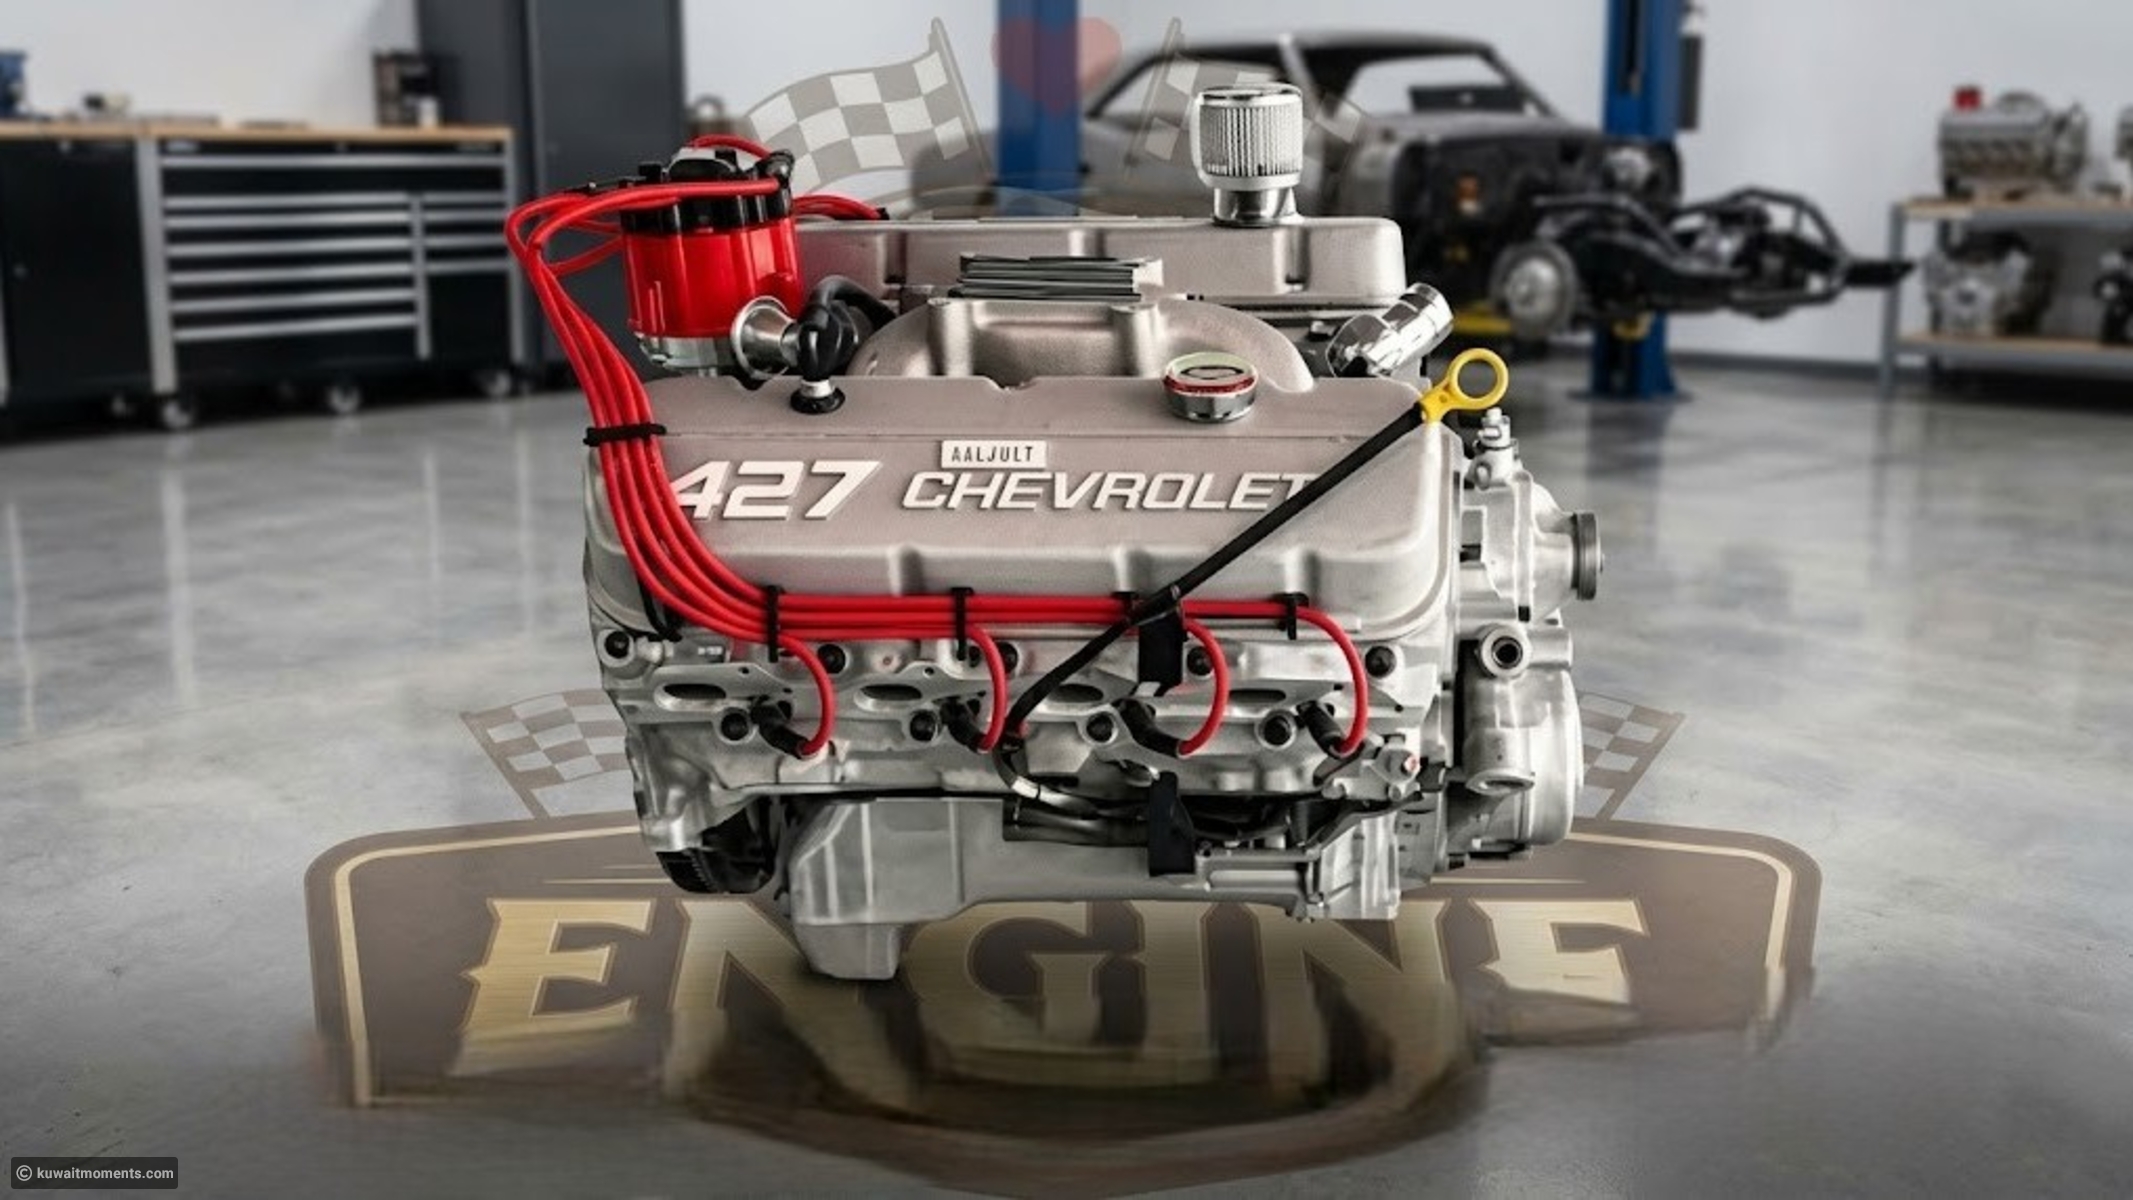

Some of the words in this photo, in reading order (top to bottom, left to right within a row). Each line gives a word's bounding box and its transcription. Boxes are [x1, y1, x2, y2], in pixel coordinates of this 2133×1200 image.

[669, 460, 883, 520] 427
[902, 472, 1321, 509] CHEVROLET
[450, 898, 1650, 1105] ENGINE
